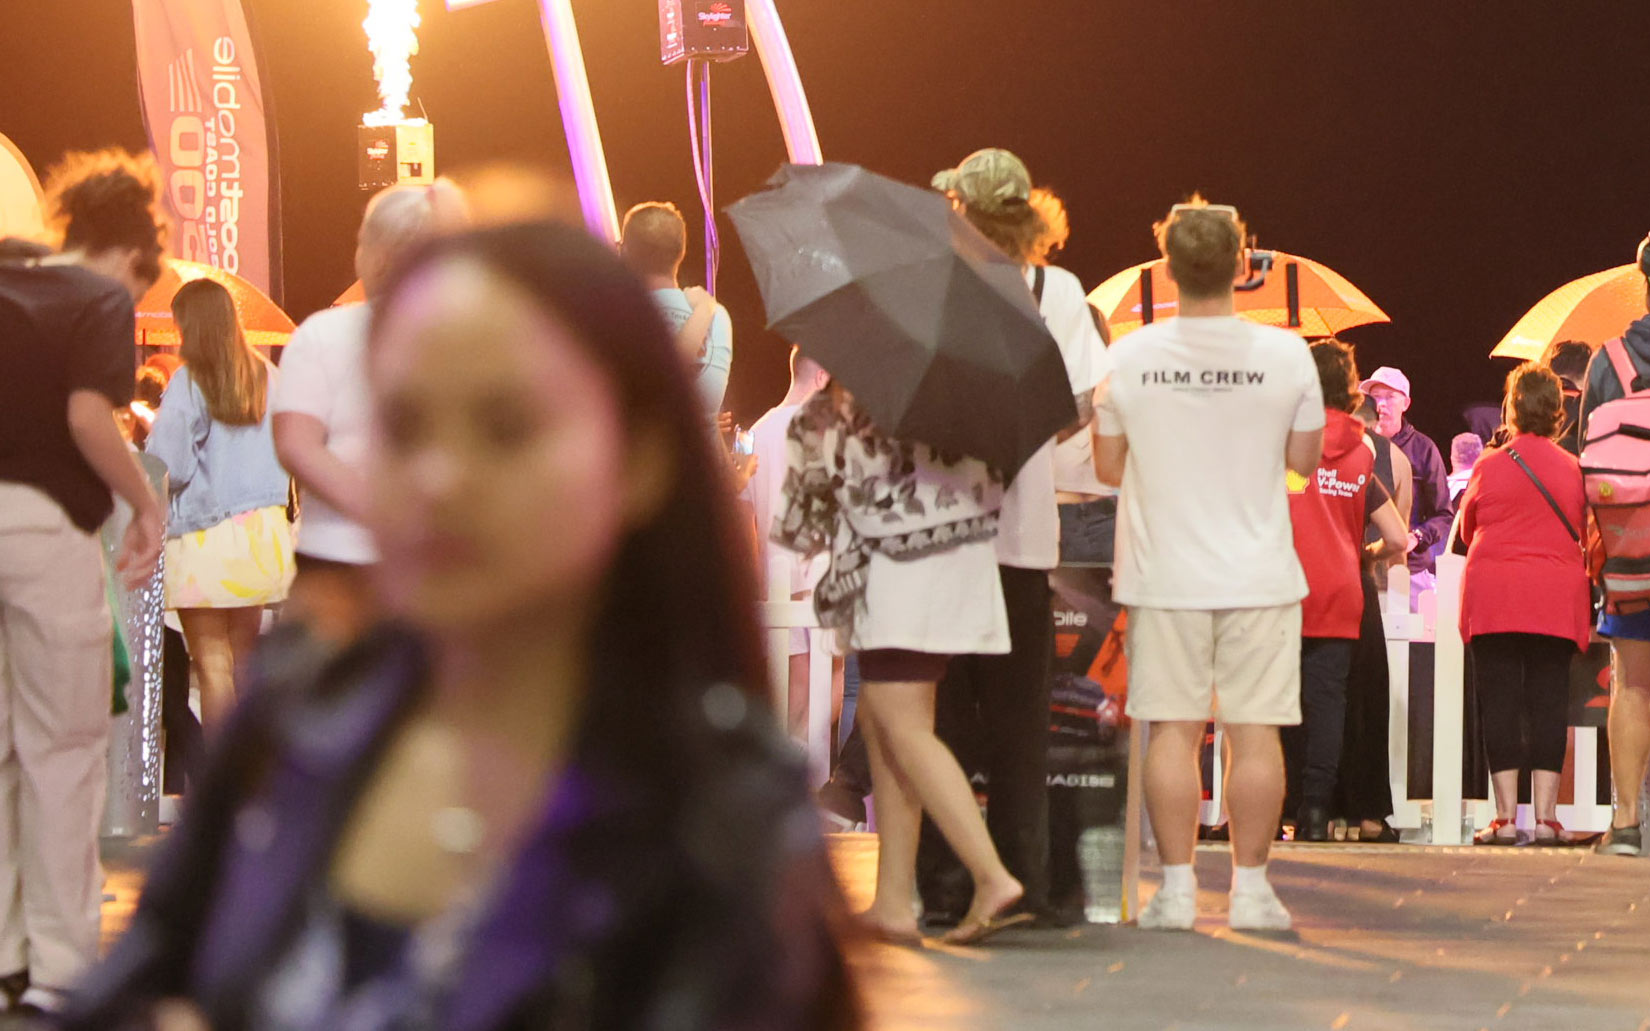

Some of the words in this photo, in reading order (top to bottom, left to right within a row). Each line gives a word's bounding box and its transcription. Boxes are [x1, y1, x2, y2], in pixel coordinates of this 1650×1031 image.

[1142, 370, 1191, 386] FILM
[1200, 370, 1265, 385] CREW
[1317, 467, 1338, 478] Shell
